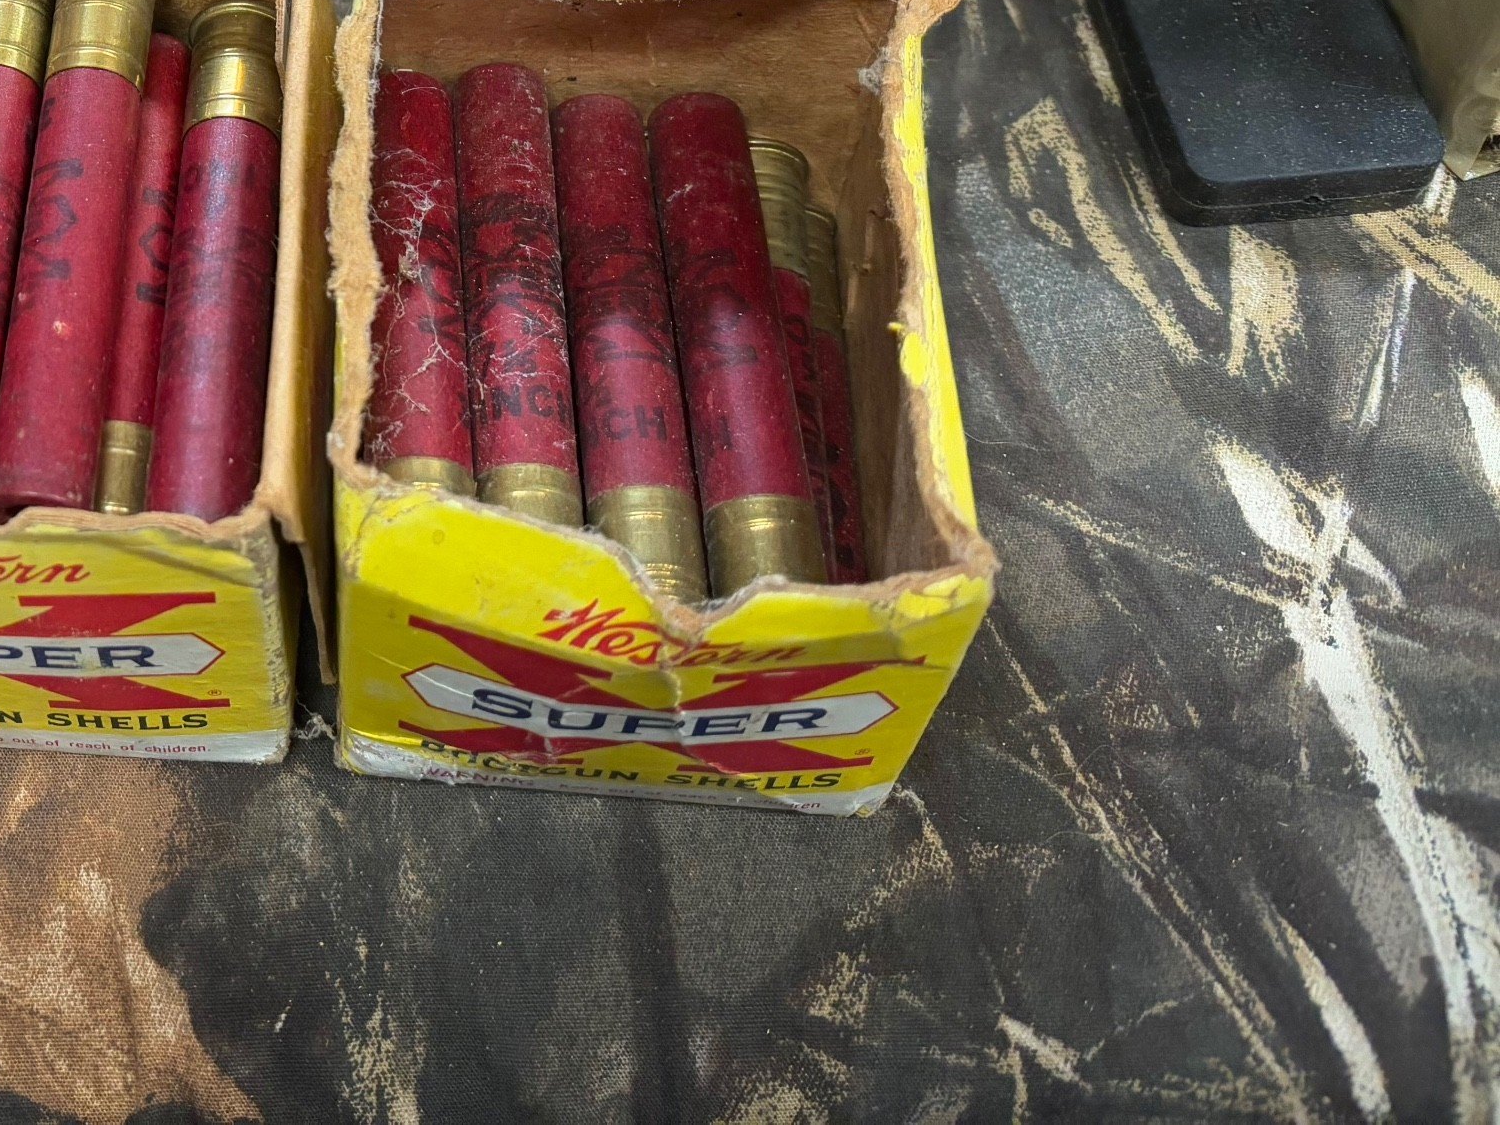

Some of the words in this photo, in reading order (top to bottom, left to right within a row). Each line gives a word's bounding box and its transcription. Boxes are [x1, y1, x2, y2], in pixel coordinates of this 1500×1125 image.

[535, 598, 807, 668] Western
[46, 712, 208, 730] SHELLS
[471, 687, 830, 737] SUPER
[12, 737, 37, 747] out
[45, 739, 59, 747] of
[69, 740, 111, 751] reach
[120, 743, 135, 752] of
[663, 773, 842, 790] SHELLS
